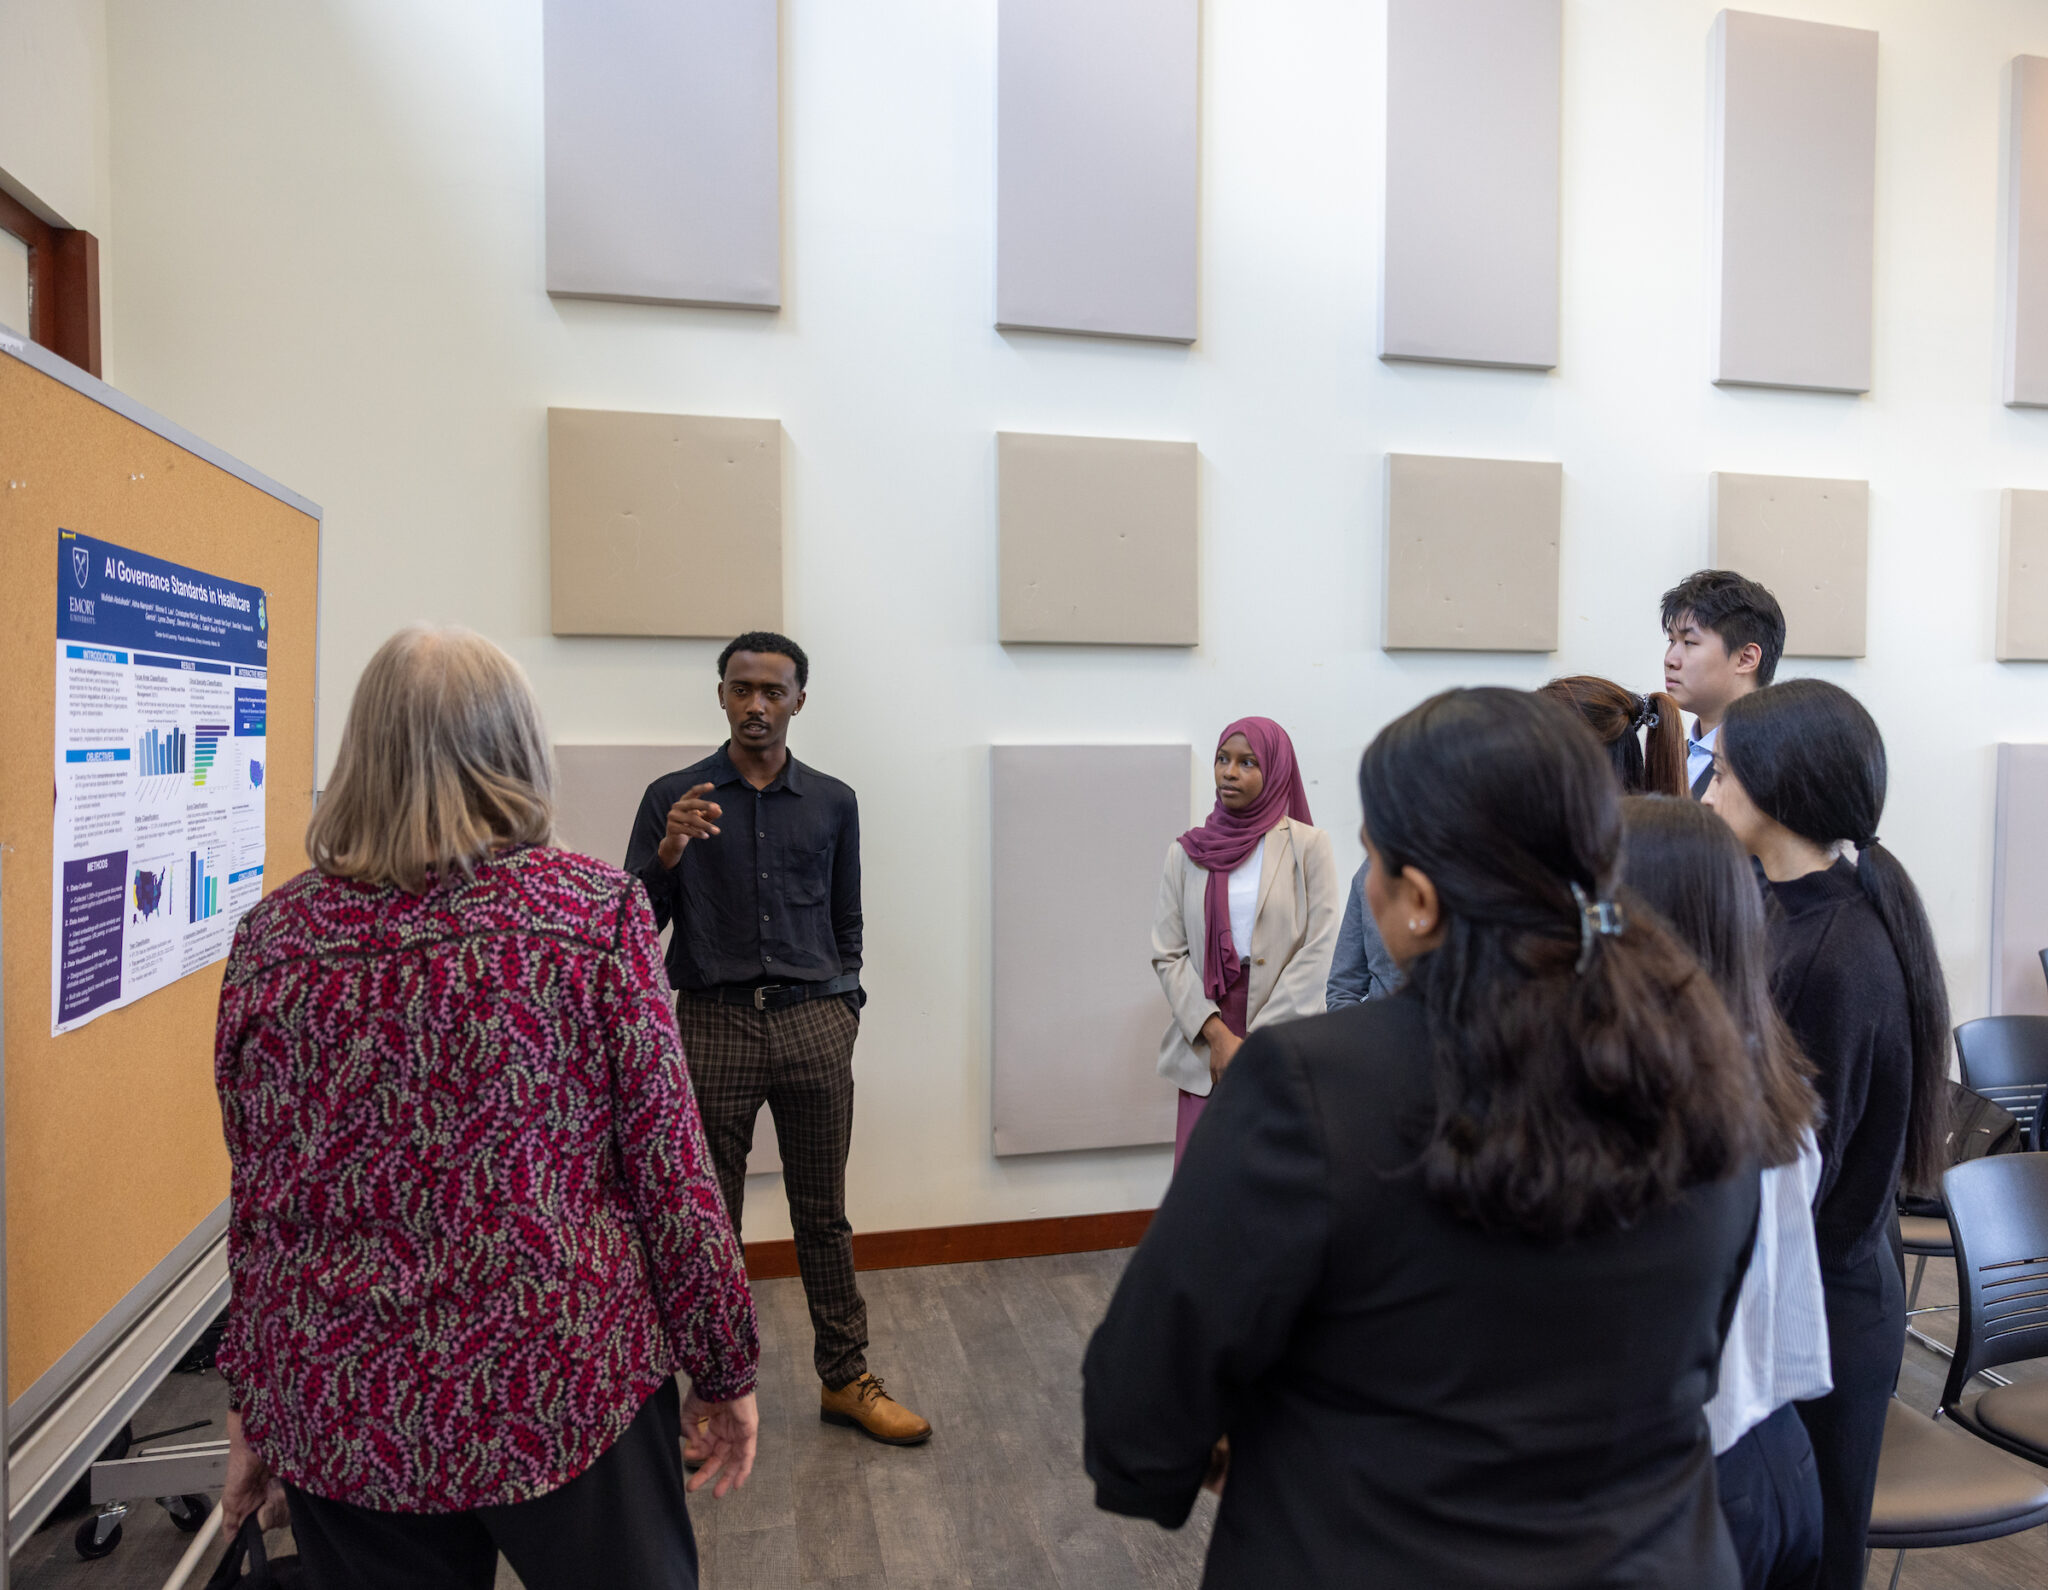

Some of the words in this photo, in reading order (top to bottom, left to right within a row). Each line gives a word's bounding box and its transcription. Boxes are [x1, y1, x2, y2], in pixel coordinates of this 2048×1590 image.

[105, 557, 115, 579] AI
[117, 560, 170, 592] Governance
[171, 575, 208, 602] Standards
[208, 586, 217, 604] in
[217, 588, 250, 613] Healthcare
[69, 596, 95, 615] EMORY
[83, 649, 117, 663] INTRODUCTION
[181, 661, 196, 671] RESULTS
[86, 751, 114, 762] OBJECTIVES
[87, 859, 108, 872] METHODS
